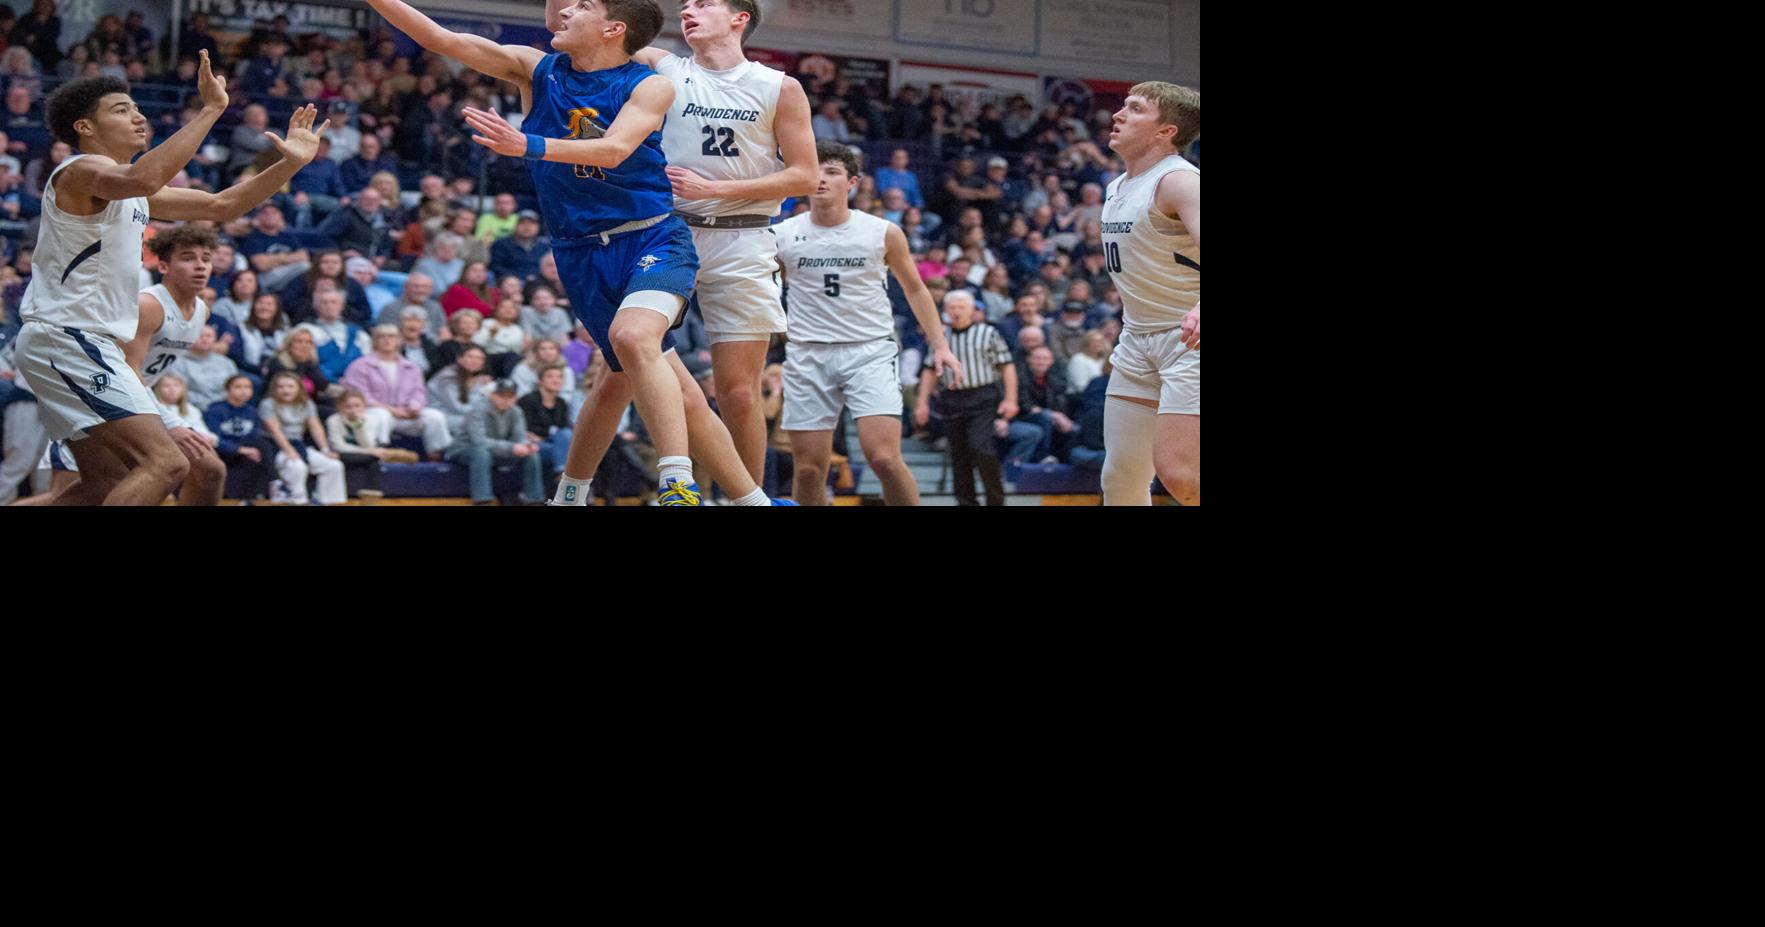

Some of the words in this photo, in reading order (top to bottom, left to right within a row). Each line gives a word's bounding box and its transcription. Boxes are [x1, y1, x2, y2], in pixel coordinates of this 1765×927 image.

[701, 124, 740, 156] 22
[797, 256, 866, 269] PROVIDENCE
[1104, 241, 1122, 273] 10
[823, 273, 840, 297] 5
[145, 352, 177, 375] 20
